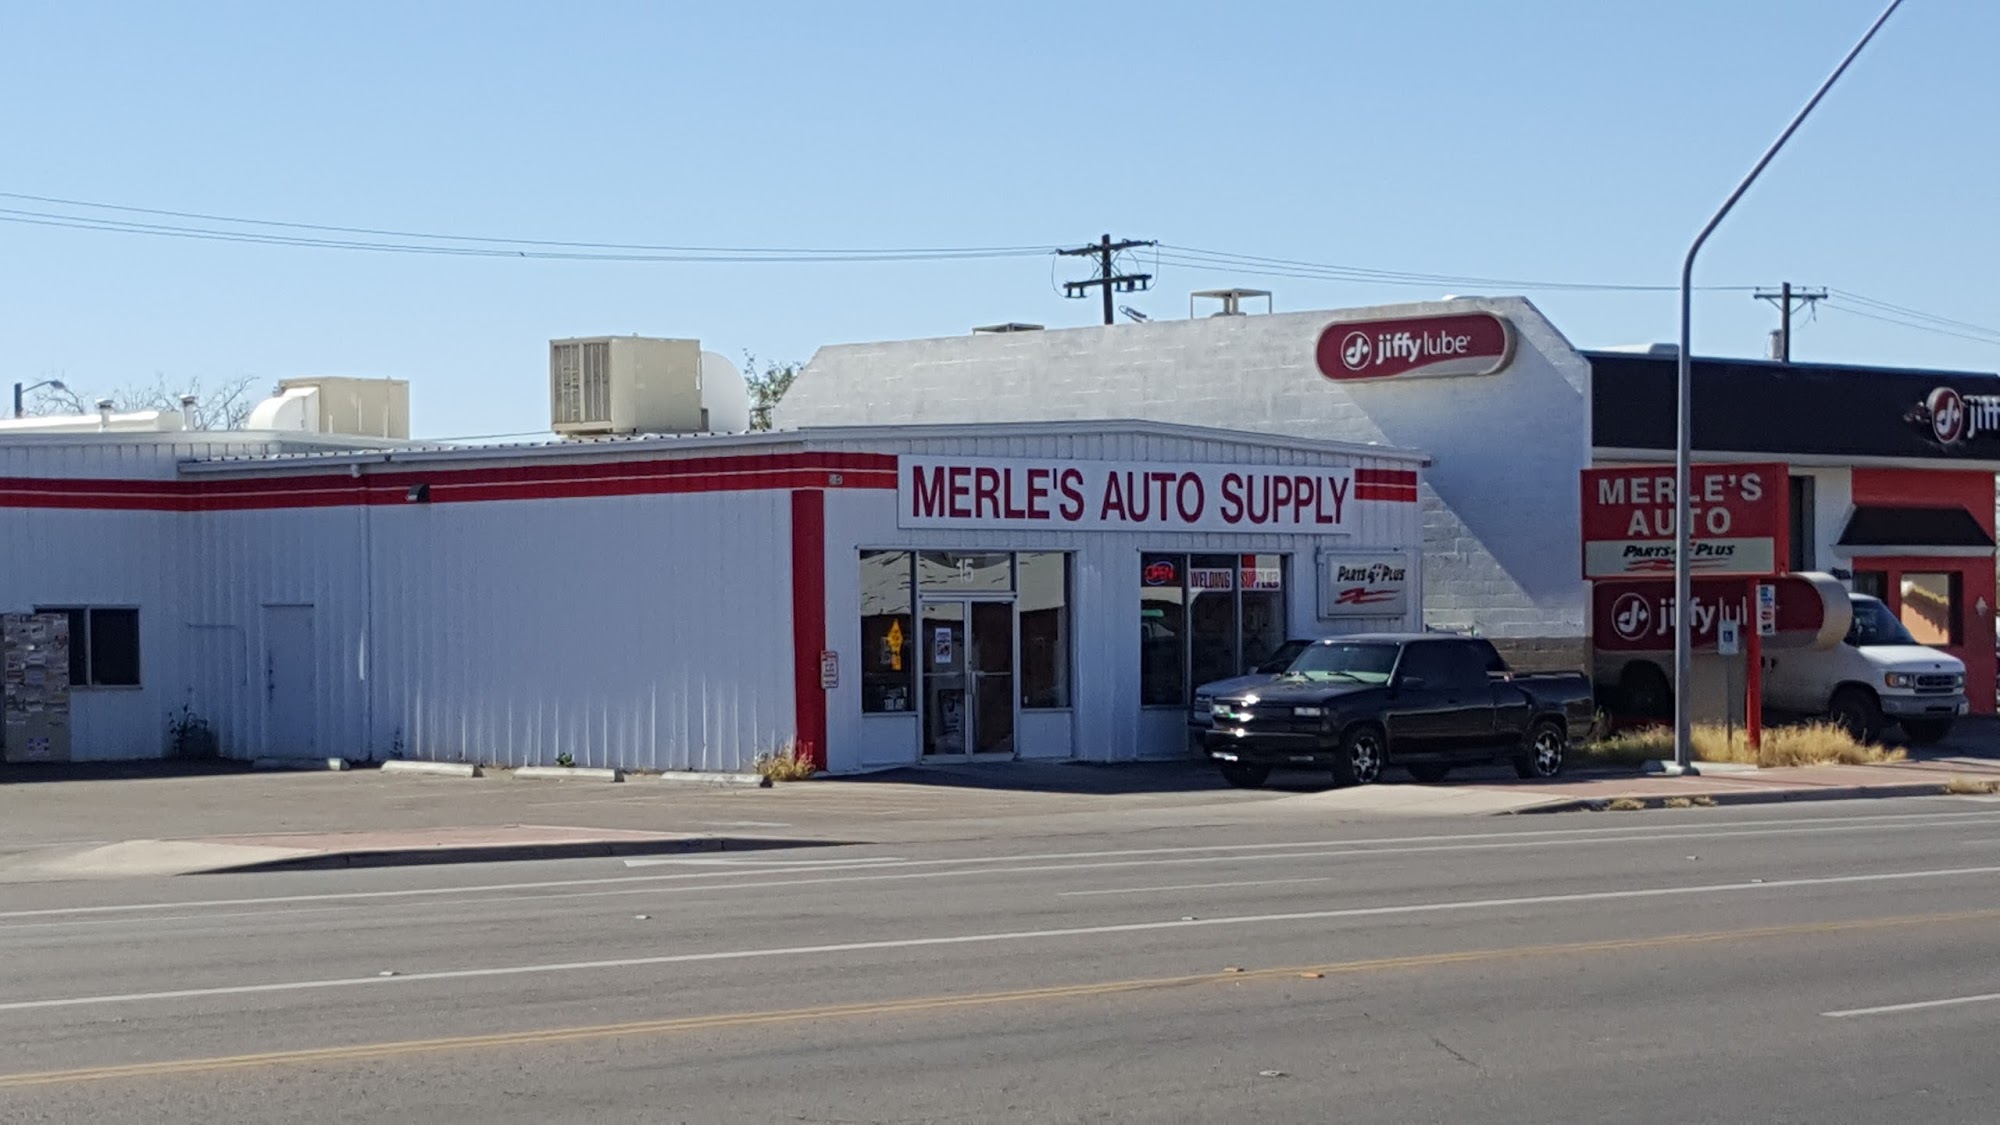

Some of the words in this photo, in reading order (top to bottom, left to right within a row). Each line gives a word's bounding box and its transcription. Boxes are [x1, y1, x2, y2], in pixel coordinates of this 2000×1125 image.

[1375, 331, 1421, 365] jiffy
[1423, 330, 1468, 356] lube
[912, 465, 1085, 521] MERLE'S
[1100, 470, 1205, 522] AUTO
[1220, 471, 1350, 525] SUPPLY
[1623, 544, 1671, 558] PARTS
[1695, 543, 1735, 556] PLUS
[956, 558, 974, 584] 15
[1144, 563, 1175, 582] OPEN
[1190, 571, 1231, 588] WELDING
[1337, 563, 1367, 583] PARTS
[1381, 562, 1406, 582] PLUS
